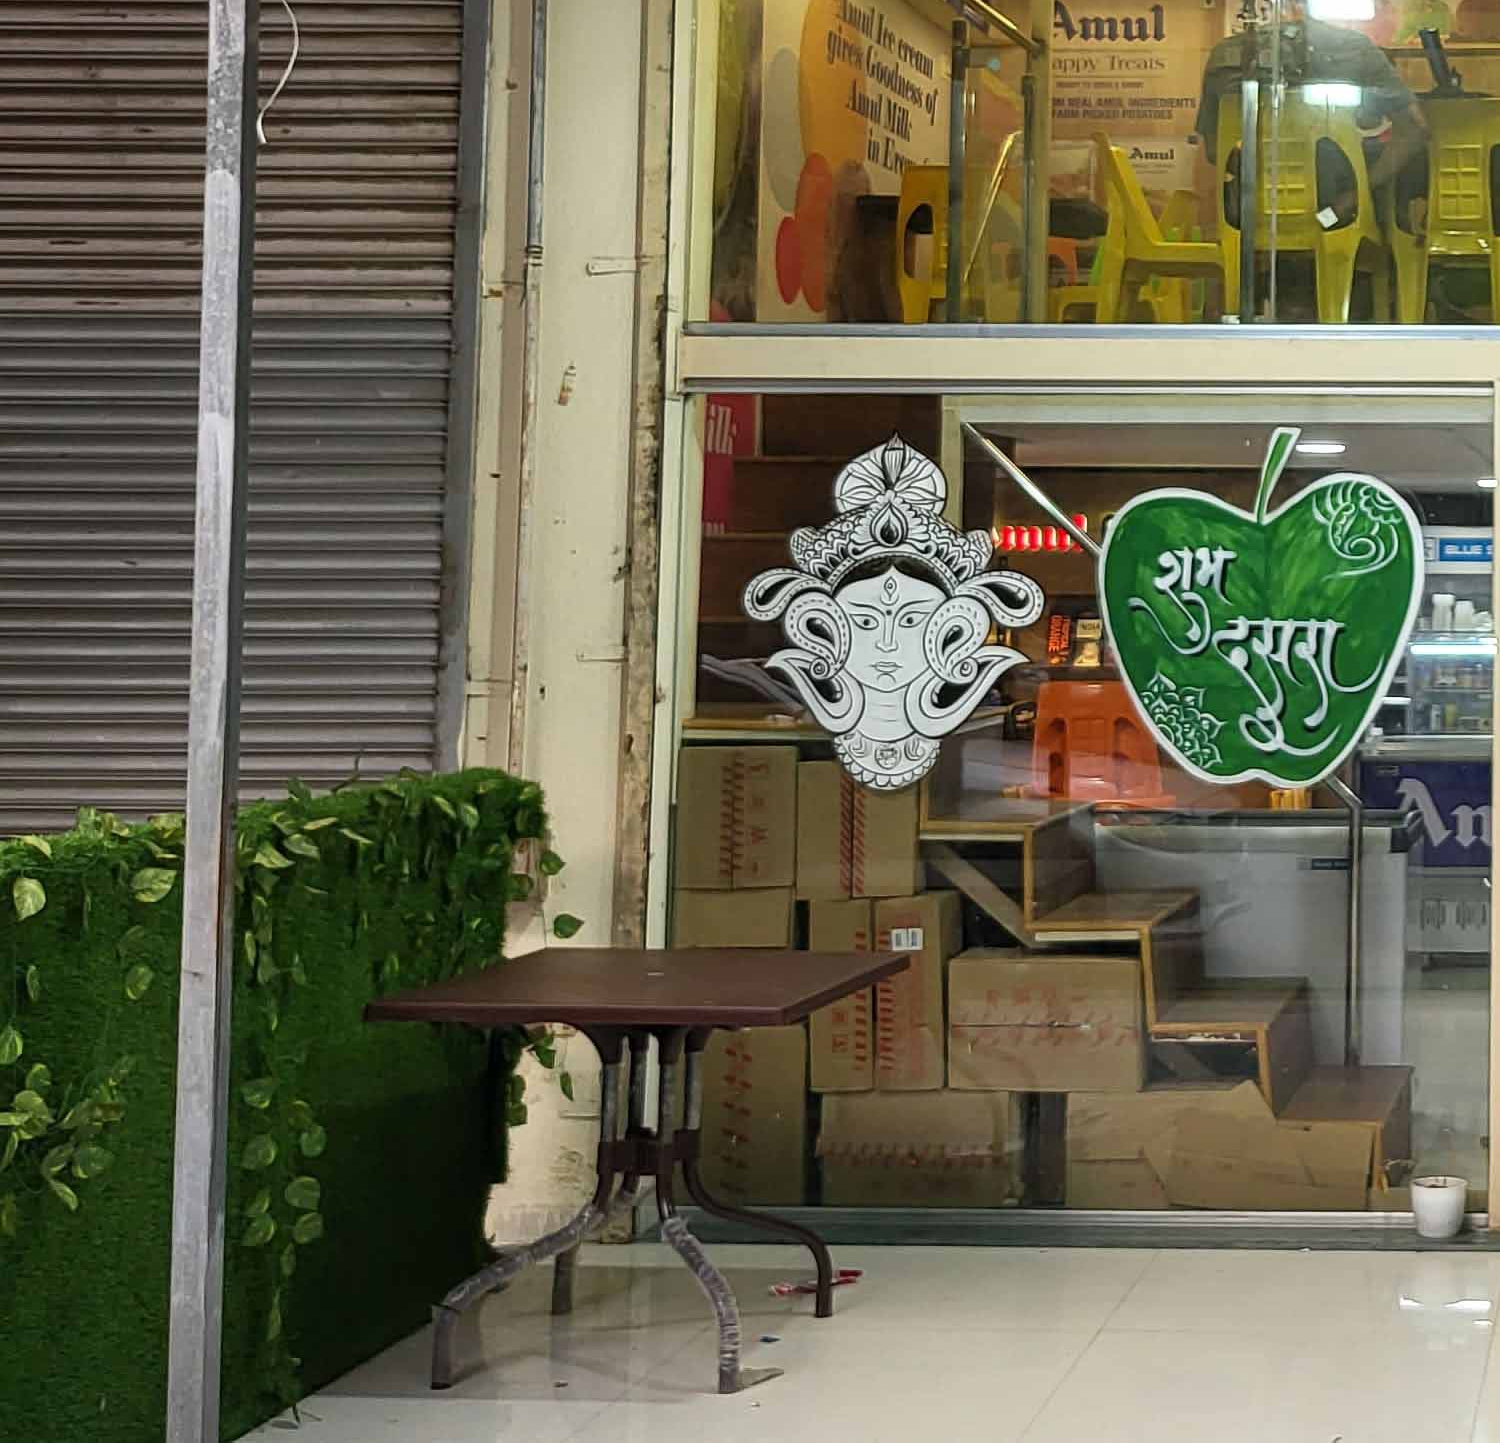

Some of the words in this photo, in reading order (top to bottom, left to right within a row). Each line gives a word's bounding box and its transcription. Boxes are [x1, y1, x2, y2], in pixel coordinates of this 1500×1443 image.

[1053, 0, 1165, 42] Amul
[898, 38, 934, 79] cream
[1051, 59, 1097, 73] appy
[866, 45, 923, 108] Goodness
[926, 88, 938, 126] of
[1128, 147, 1174, 160] Amul
[992, 514, 1088, 552] mul
[1444, 543, 1482, 556] BLUE
